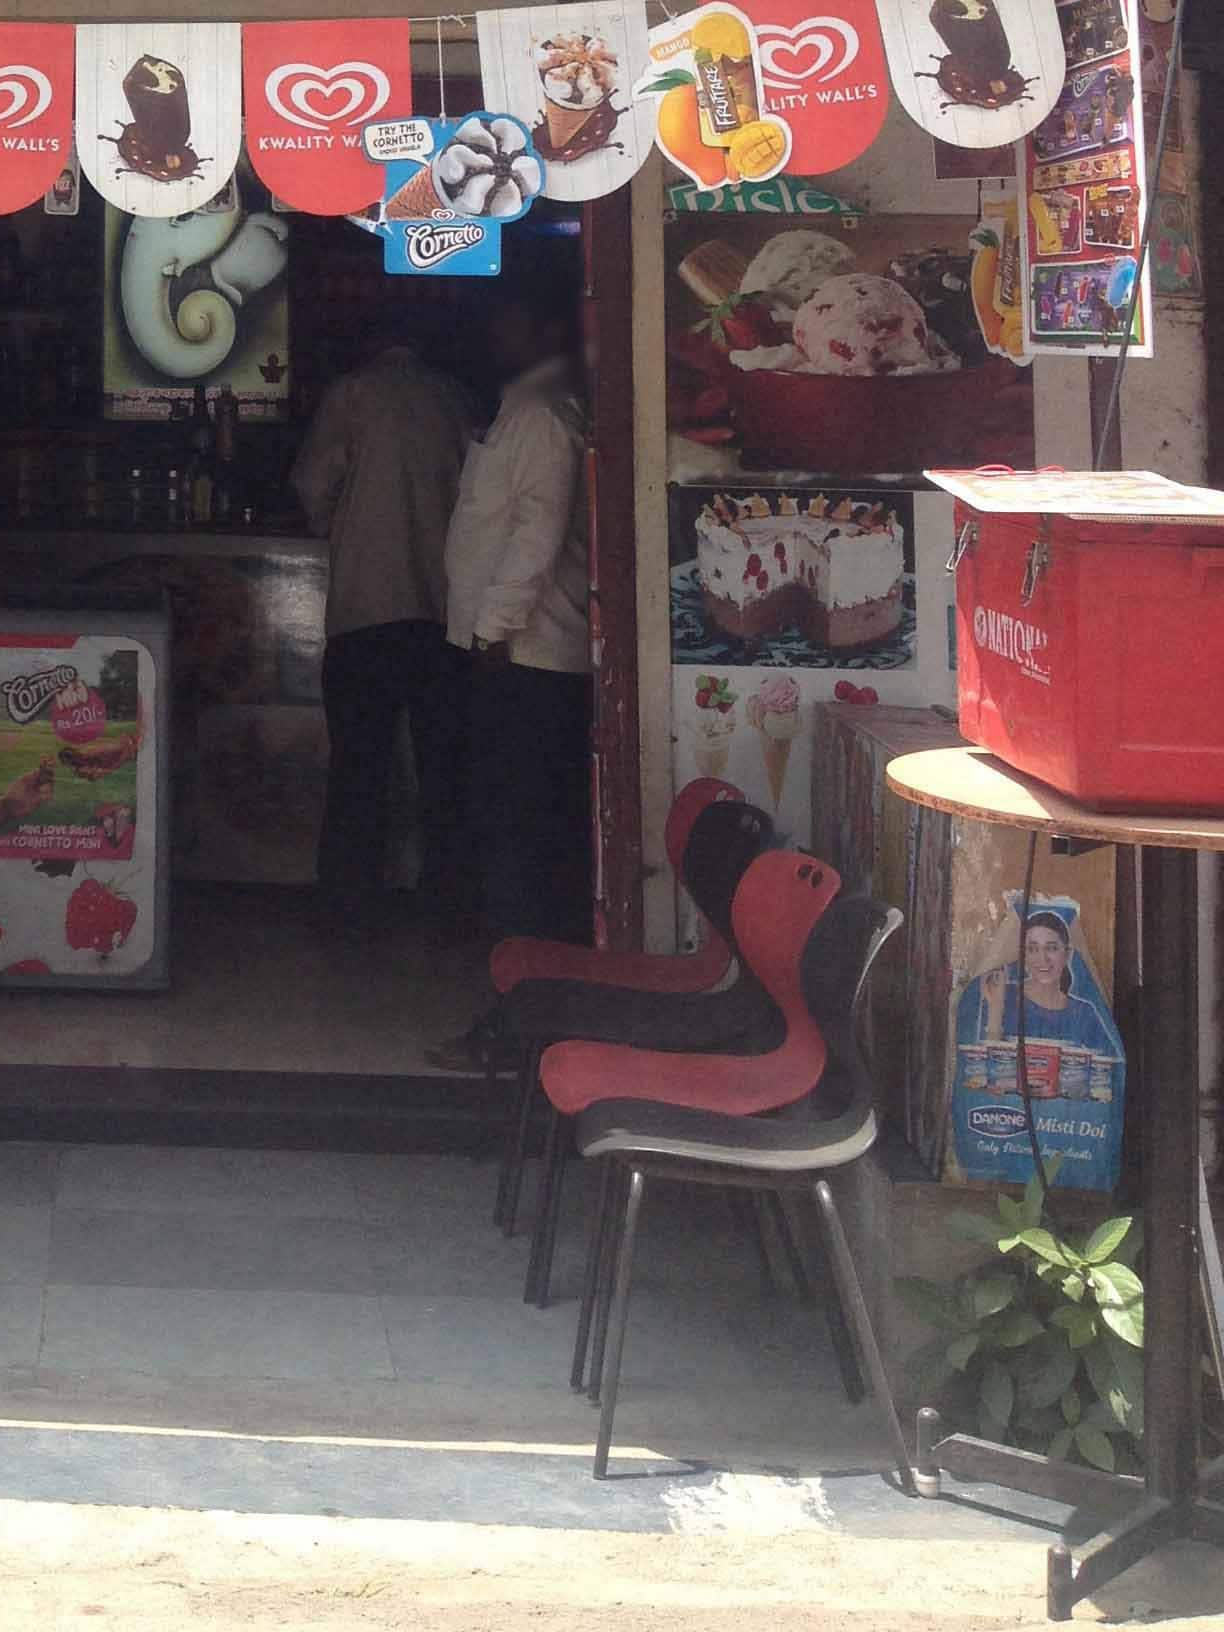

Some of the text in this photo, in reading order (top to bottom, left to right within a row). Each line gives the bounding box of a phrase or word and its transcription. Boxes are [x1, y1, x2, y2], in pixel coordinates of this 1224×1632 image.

[816, 84, 878, 104] WALL'S
[378, 123, 416, 137] TRY THE
[2, 136, 60, 152] WALL'S
[259, 135, 335, 151] KWALITY
[373, 132, 425, 149] CORNETTO
[404, 222, 485, 269] Cornetto
[1, 665, 78, 725] Cornetto
[972, 1111, 1026, 1128] DANONE
